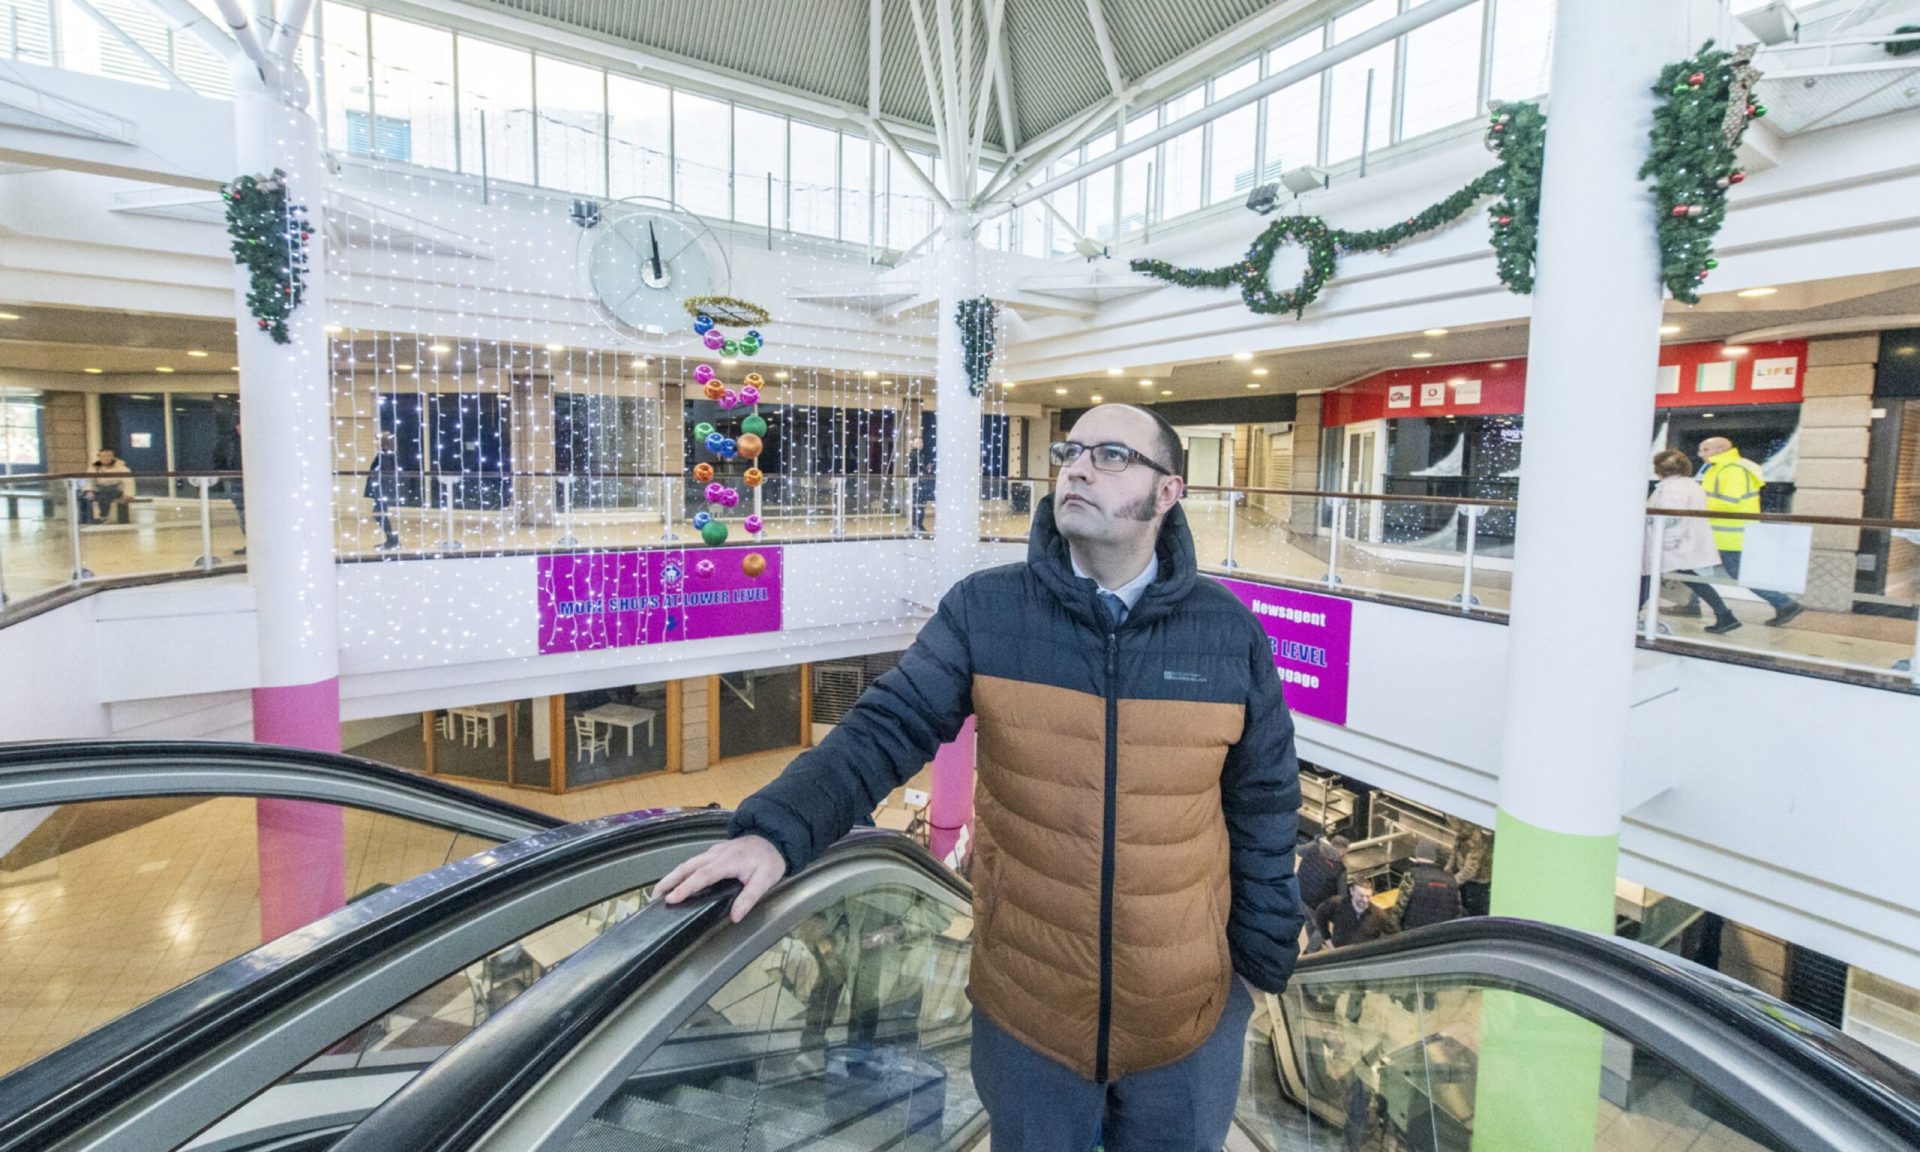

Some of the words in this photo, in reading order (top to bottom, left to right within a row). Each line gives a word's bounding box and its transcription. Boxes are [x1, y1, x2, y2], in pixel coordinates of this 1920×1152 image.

[609, 595, 659, 613] SHOPS
[664, 593, 681, 608] AT
[682, 589, 730, 607] LOWER
[733, 587, 768, 603] LEVEL
[1252, 599, 1326, 627] Newsagent
[1281, 639, 1327, 667] LEVEL
[1277, 666, 1320, 689] ggage
